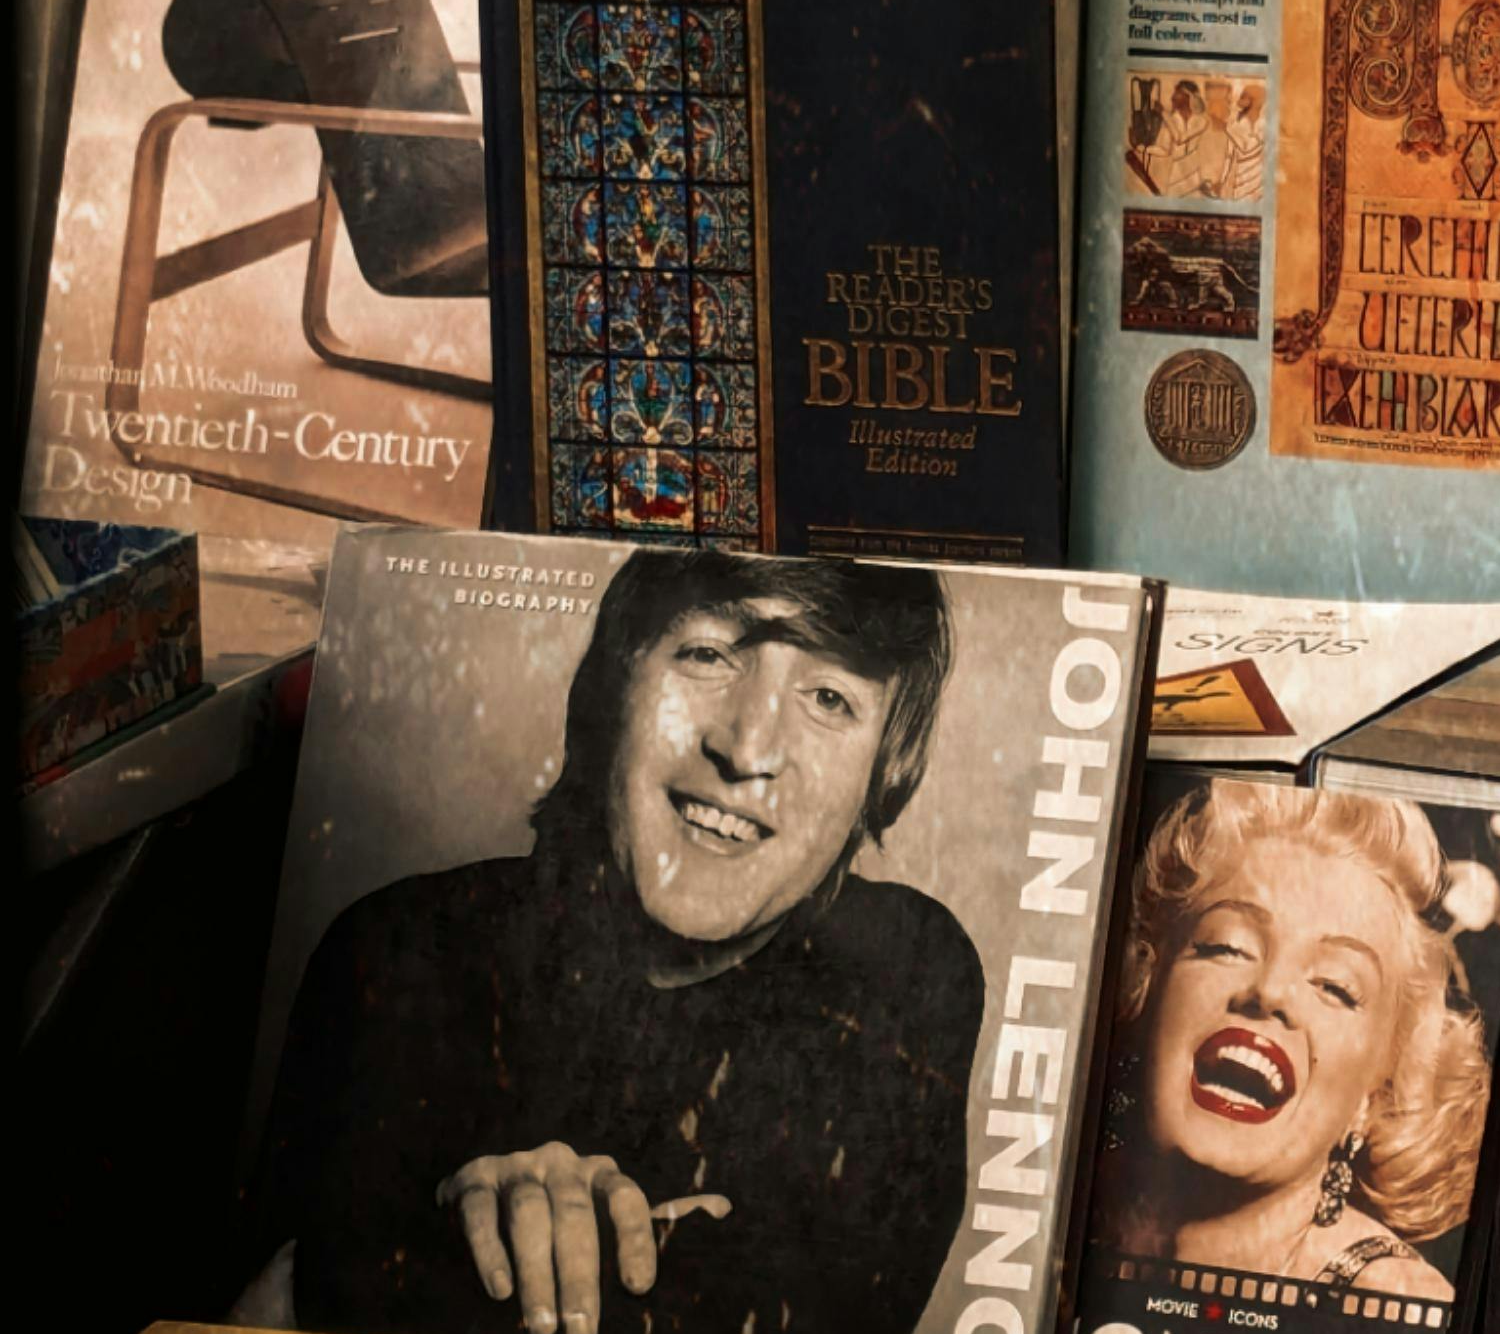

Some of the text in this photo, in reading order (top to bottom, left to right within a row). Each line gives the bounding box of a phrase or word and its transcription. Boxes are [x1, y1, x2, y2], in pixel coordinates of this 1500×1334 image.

[1128, 24, 1206, 43] full colour.
[1202, 10, 1239, 26] most
[1241, 10, 1257, 26] in
[866, 242, 943, 278] THE
[824, 269, 995, 312] READER'S
[846, 303, 976, 341] DIGEST
[800, 336, 1026, 418] BIBLE
[49, 389, 473, 483] Twentieth-Century
[848, 418, 978, 452] Illustrated
[41, 443, 194, 512] Design
[864, 446, 959, 478] Edition
[385, 555, 597, 590] THE ILLUSTRATED
[452, 588, 594, 617] BIOGRAPHY
[1174, 632, 1370, 656] SIGNS
[1018, 585, 1133, 917] JOHN
[1146, 1296, 1280, 1331] MOVIE ICONS
